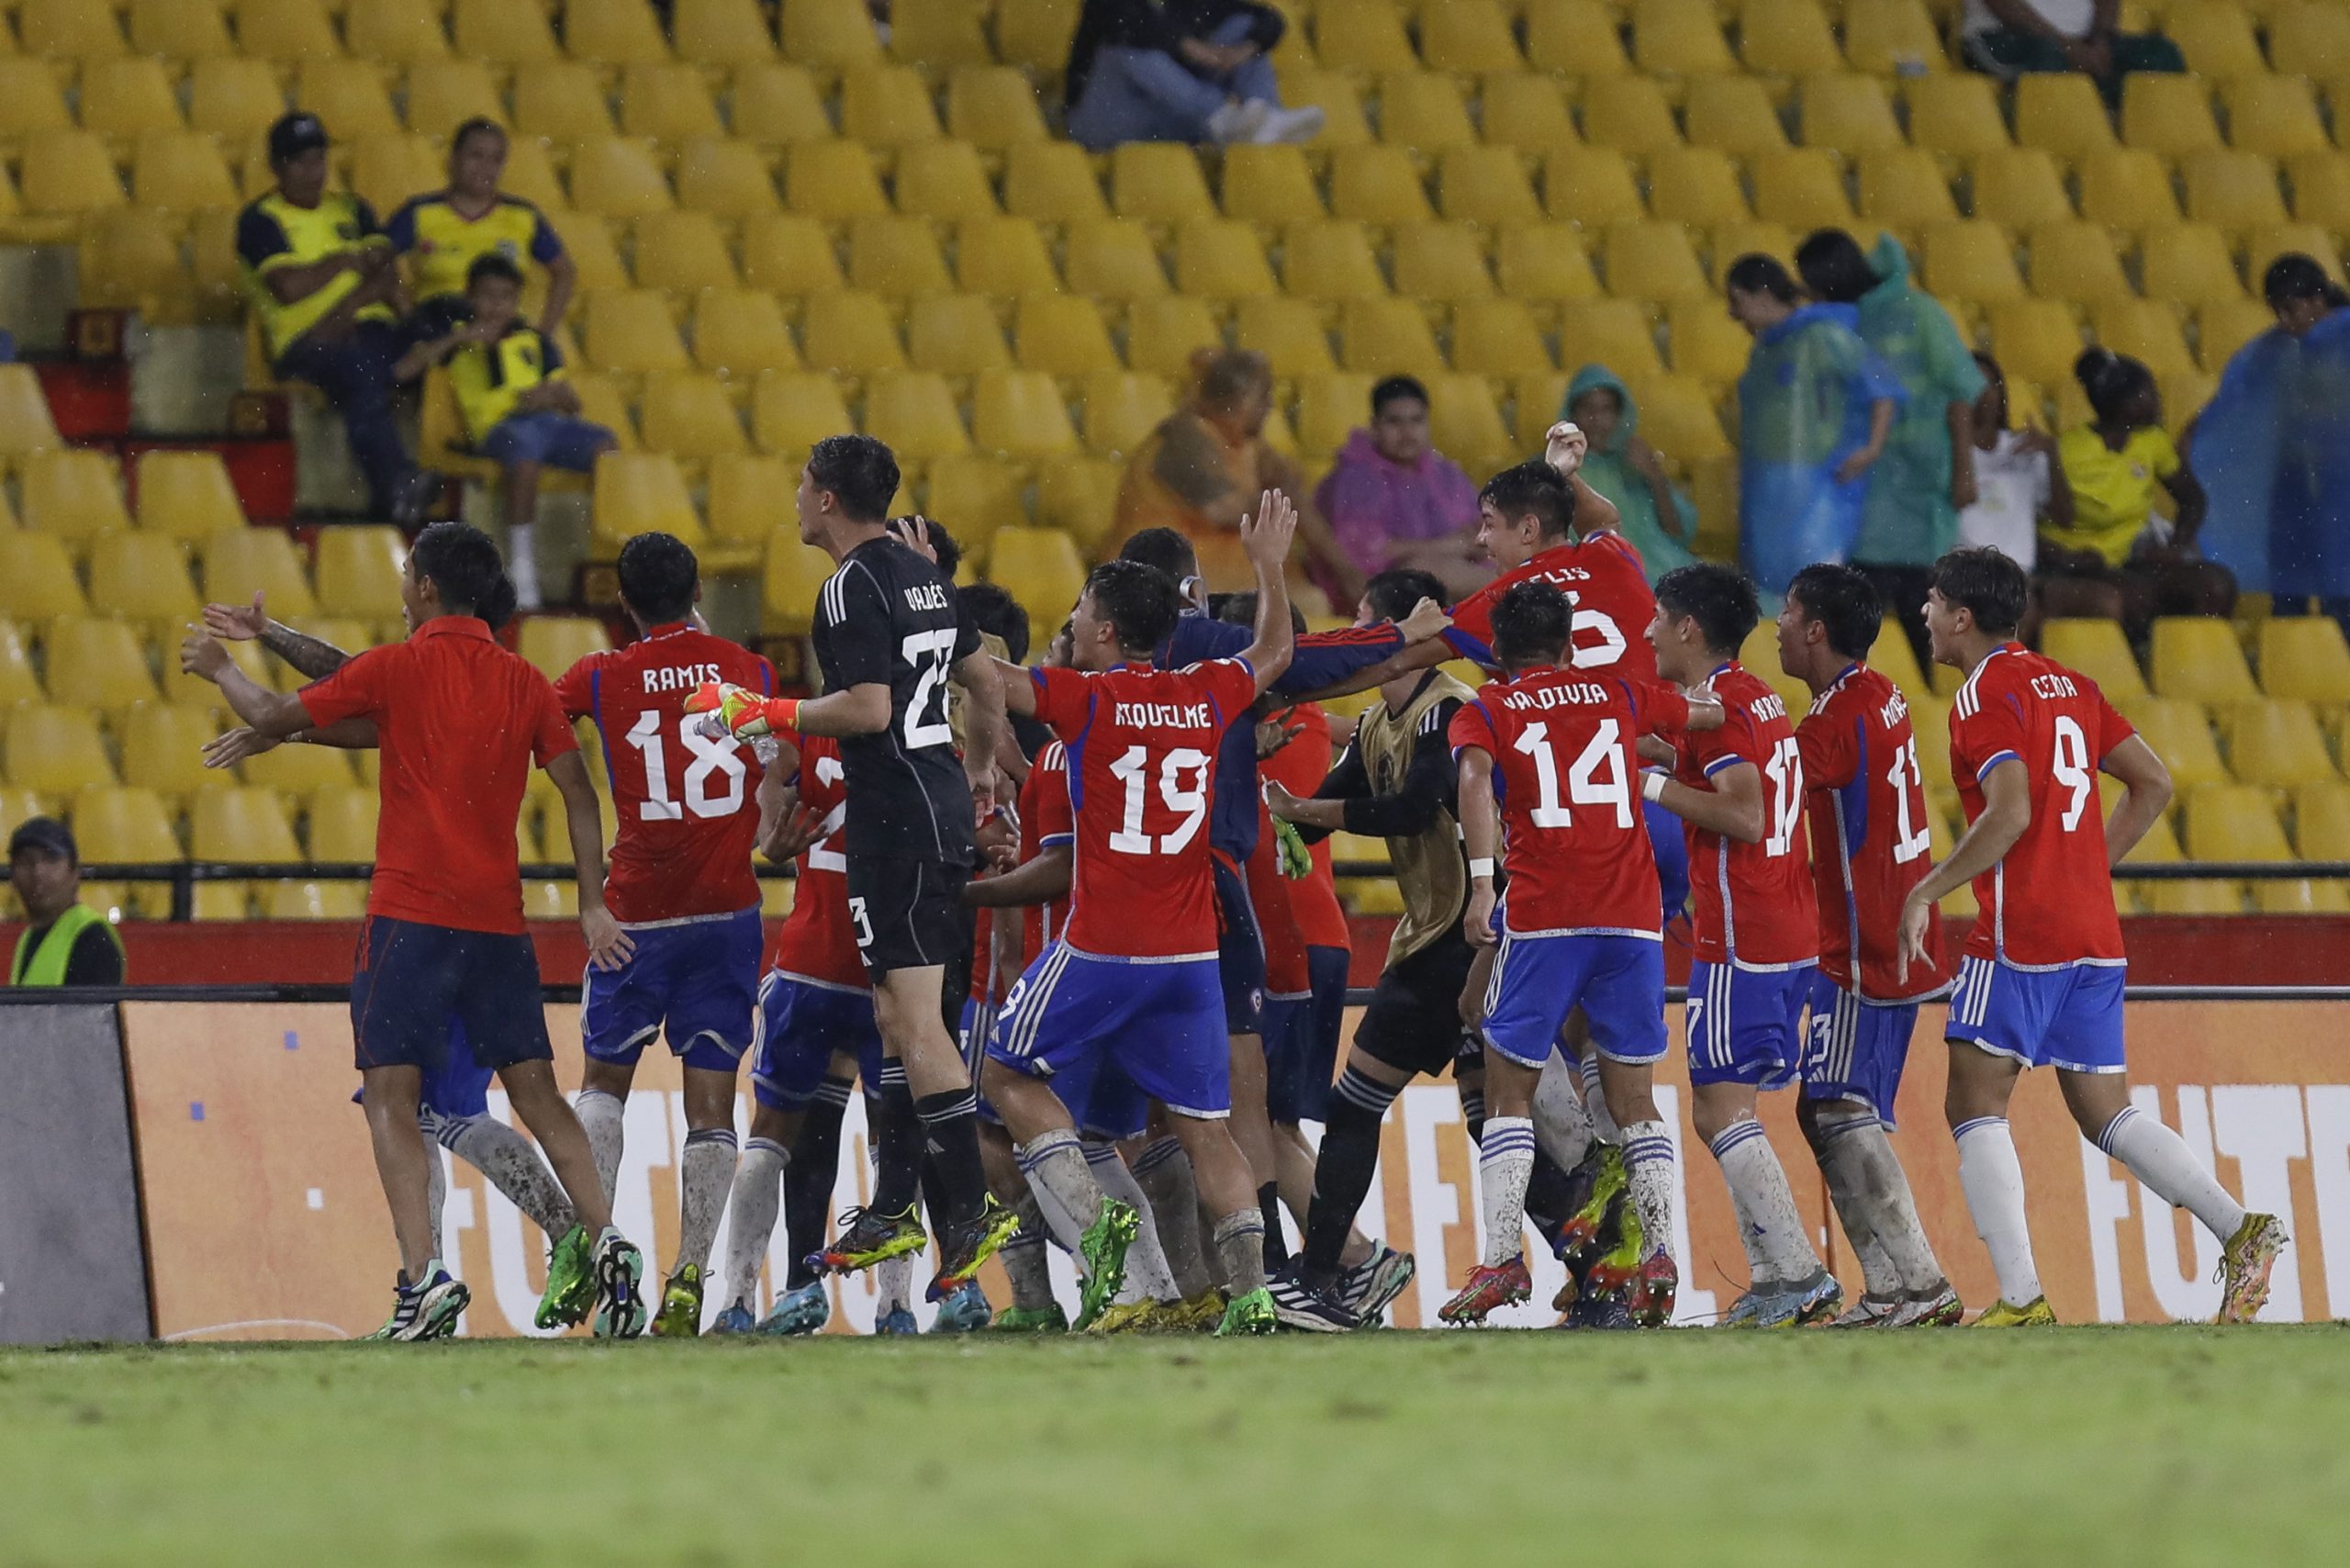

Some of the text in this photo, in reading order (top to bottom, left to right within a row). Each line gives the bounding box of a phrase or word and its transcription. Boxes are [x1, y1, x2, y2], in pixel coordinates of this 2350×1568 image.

[643, 663, 722, 694] RAMIS
[1503, 683, 1608, 711] VALDIVIA
[626, 710, 746, 821] 18
[1109, 745, 1211, 856] 19
[1514, 718, 1634, 829] 14
[1764, 736, 1804, 857] 17
[2053, 715, 2091, 833] 9
